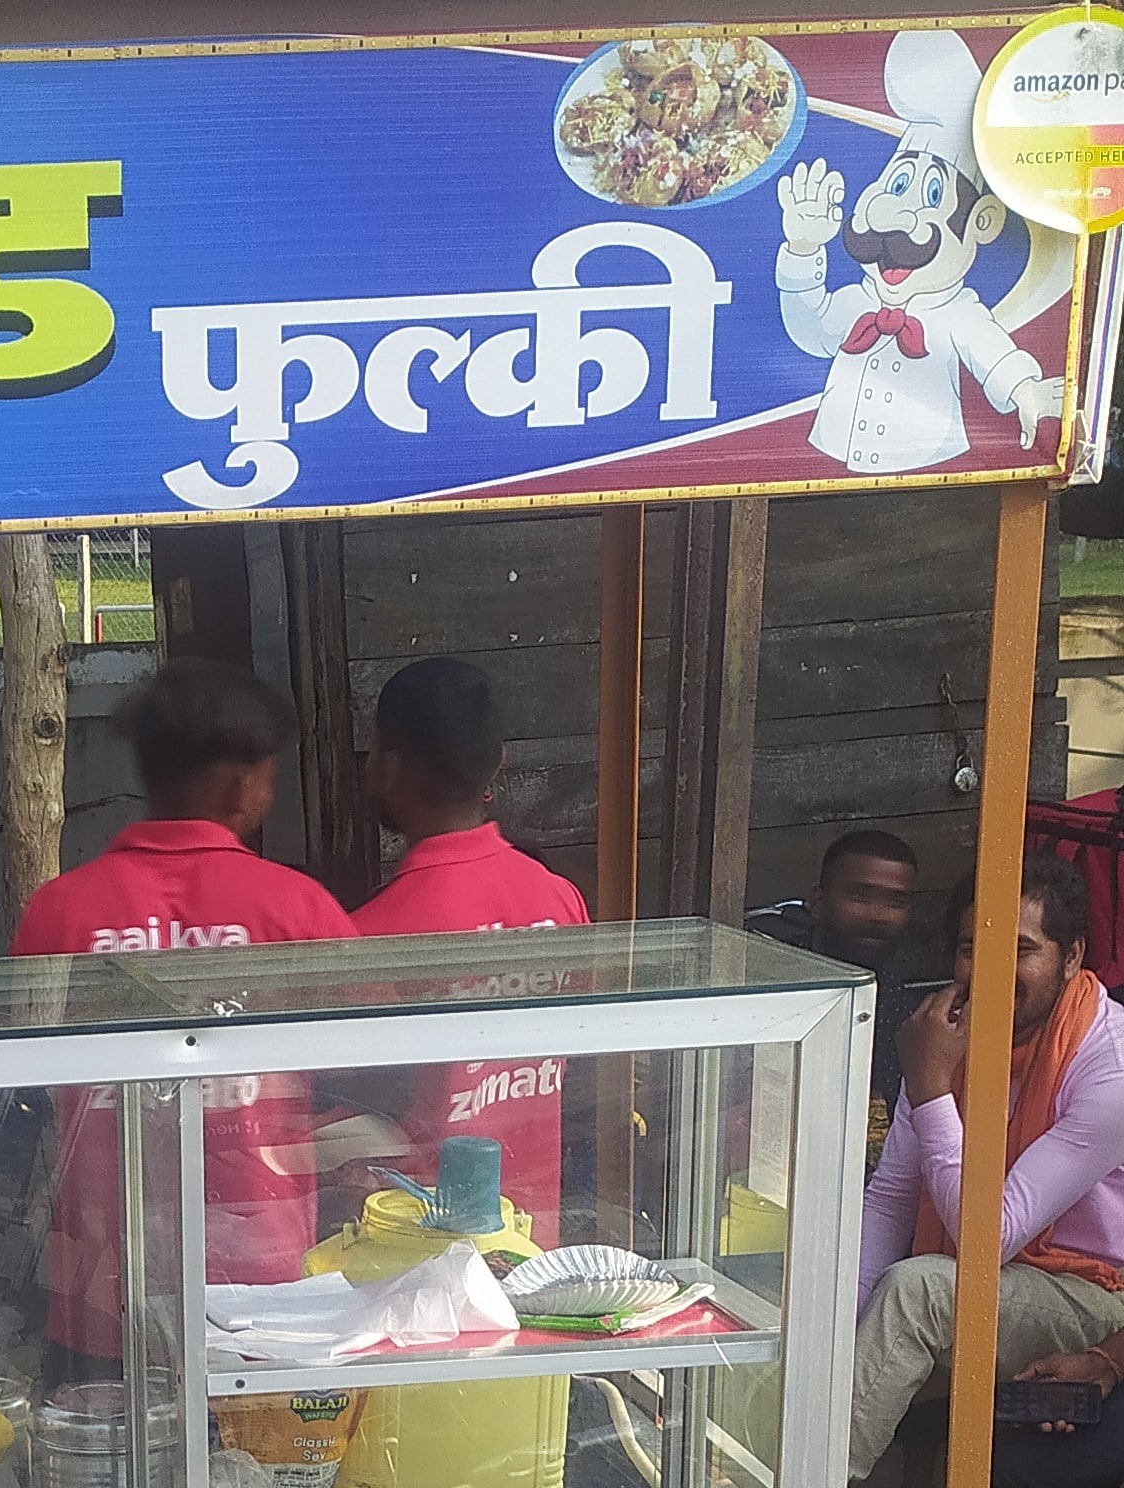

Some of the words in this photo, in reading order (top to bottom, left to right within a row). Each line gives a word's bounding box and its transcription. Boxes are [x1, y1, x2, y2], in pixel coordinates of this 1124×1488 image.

[1014, 73, 1099, 92] amazon
[1016, 151, 1094, 164] ACCEPTED
[152, 221, 732, 509] फुल्की
[292, 1396, 348, 1410] BALAJI
